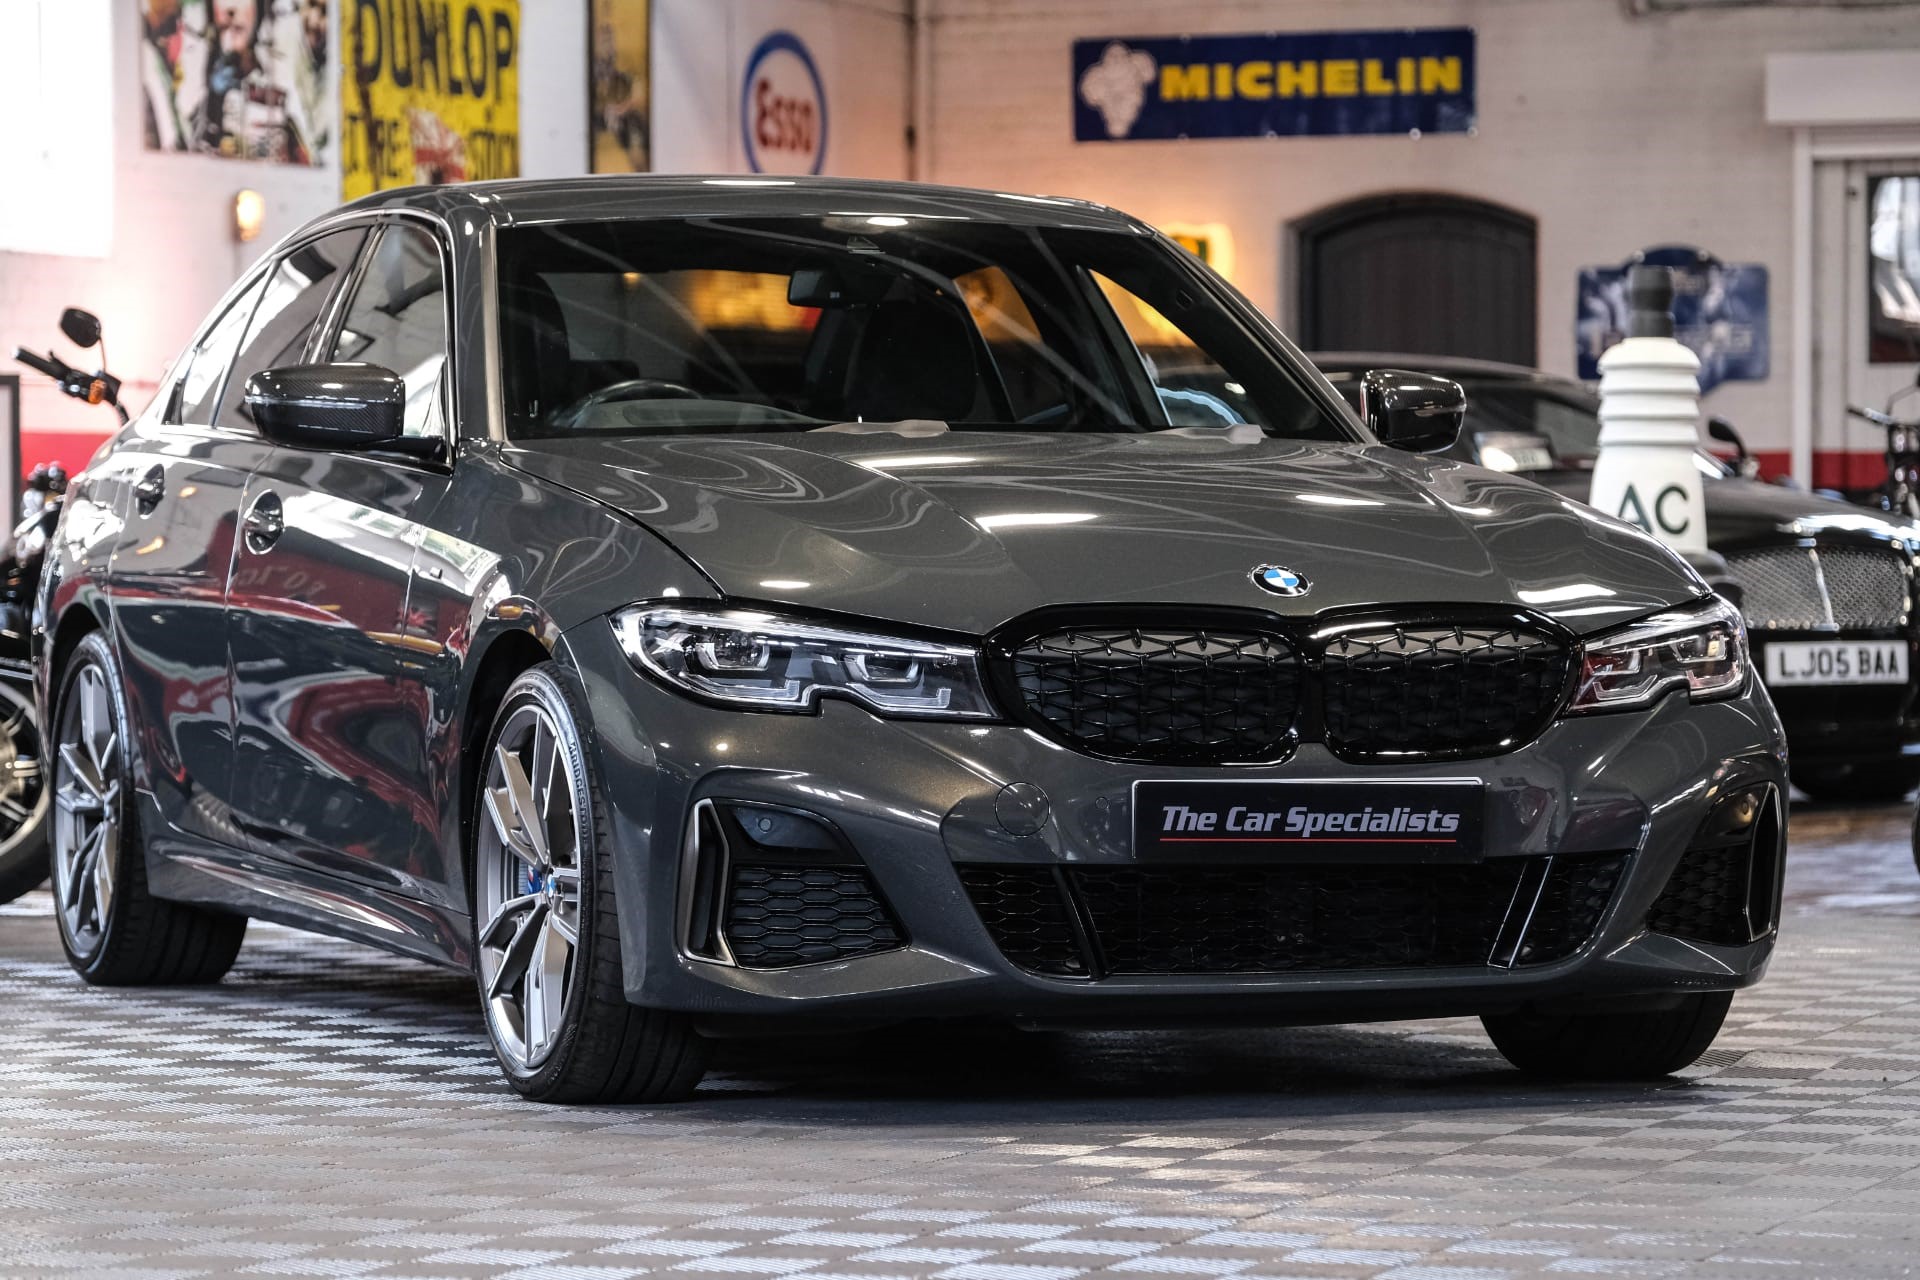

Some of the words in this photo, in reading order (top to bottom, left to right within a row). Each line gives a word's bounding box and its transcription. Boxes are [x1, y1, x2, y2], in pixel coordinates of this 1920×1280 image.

[354, 0, 513, 103] DUNLOP
[1160, 56, 1461, 101] MICHELIN
[757, 79, 813, 153] Esso
[1618, 484, 1688, 535] AC
[1780, 648, 1850, 678] LJ05
[1858, 647, 1899, 676] BAA
[1162, 806, 1217, 832] The
[1225, 806, 1281, 832] Car
[1285, 806, 1460, 838] Specialists
